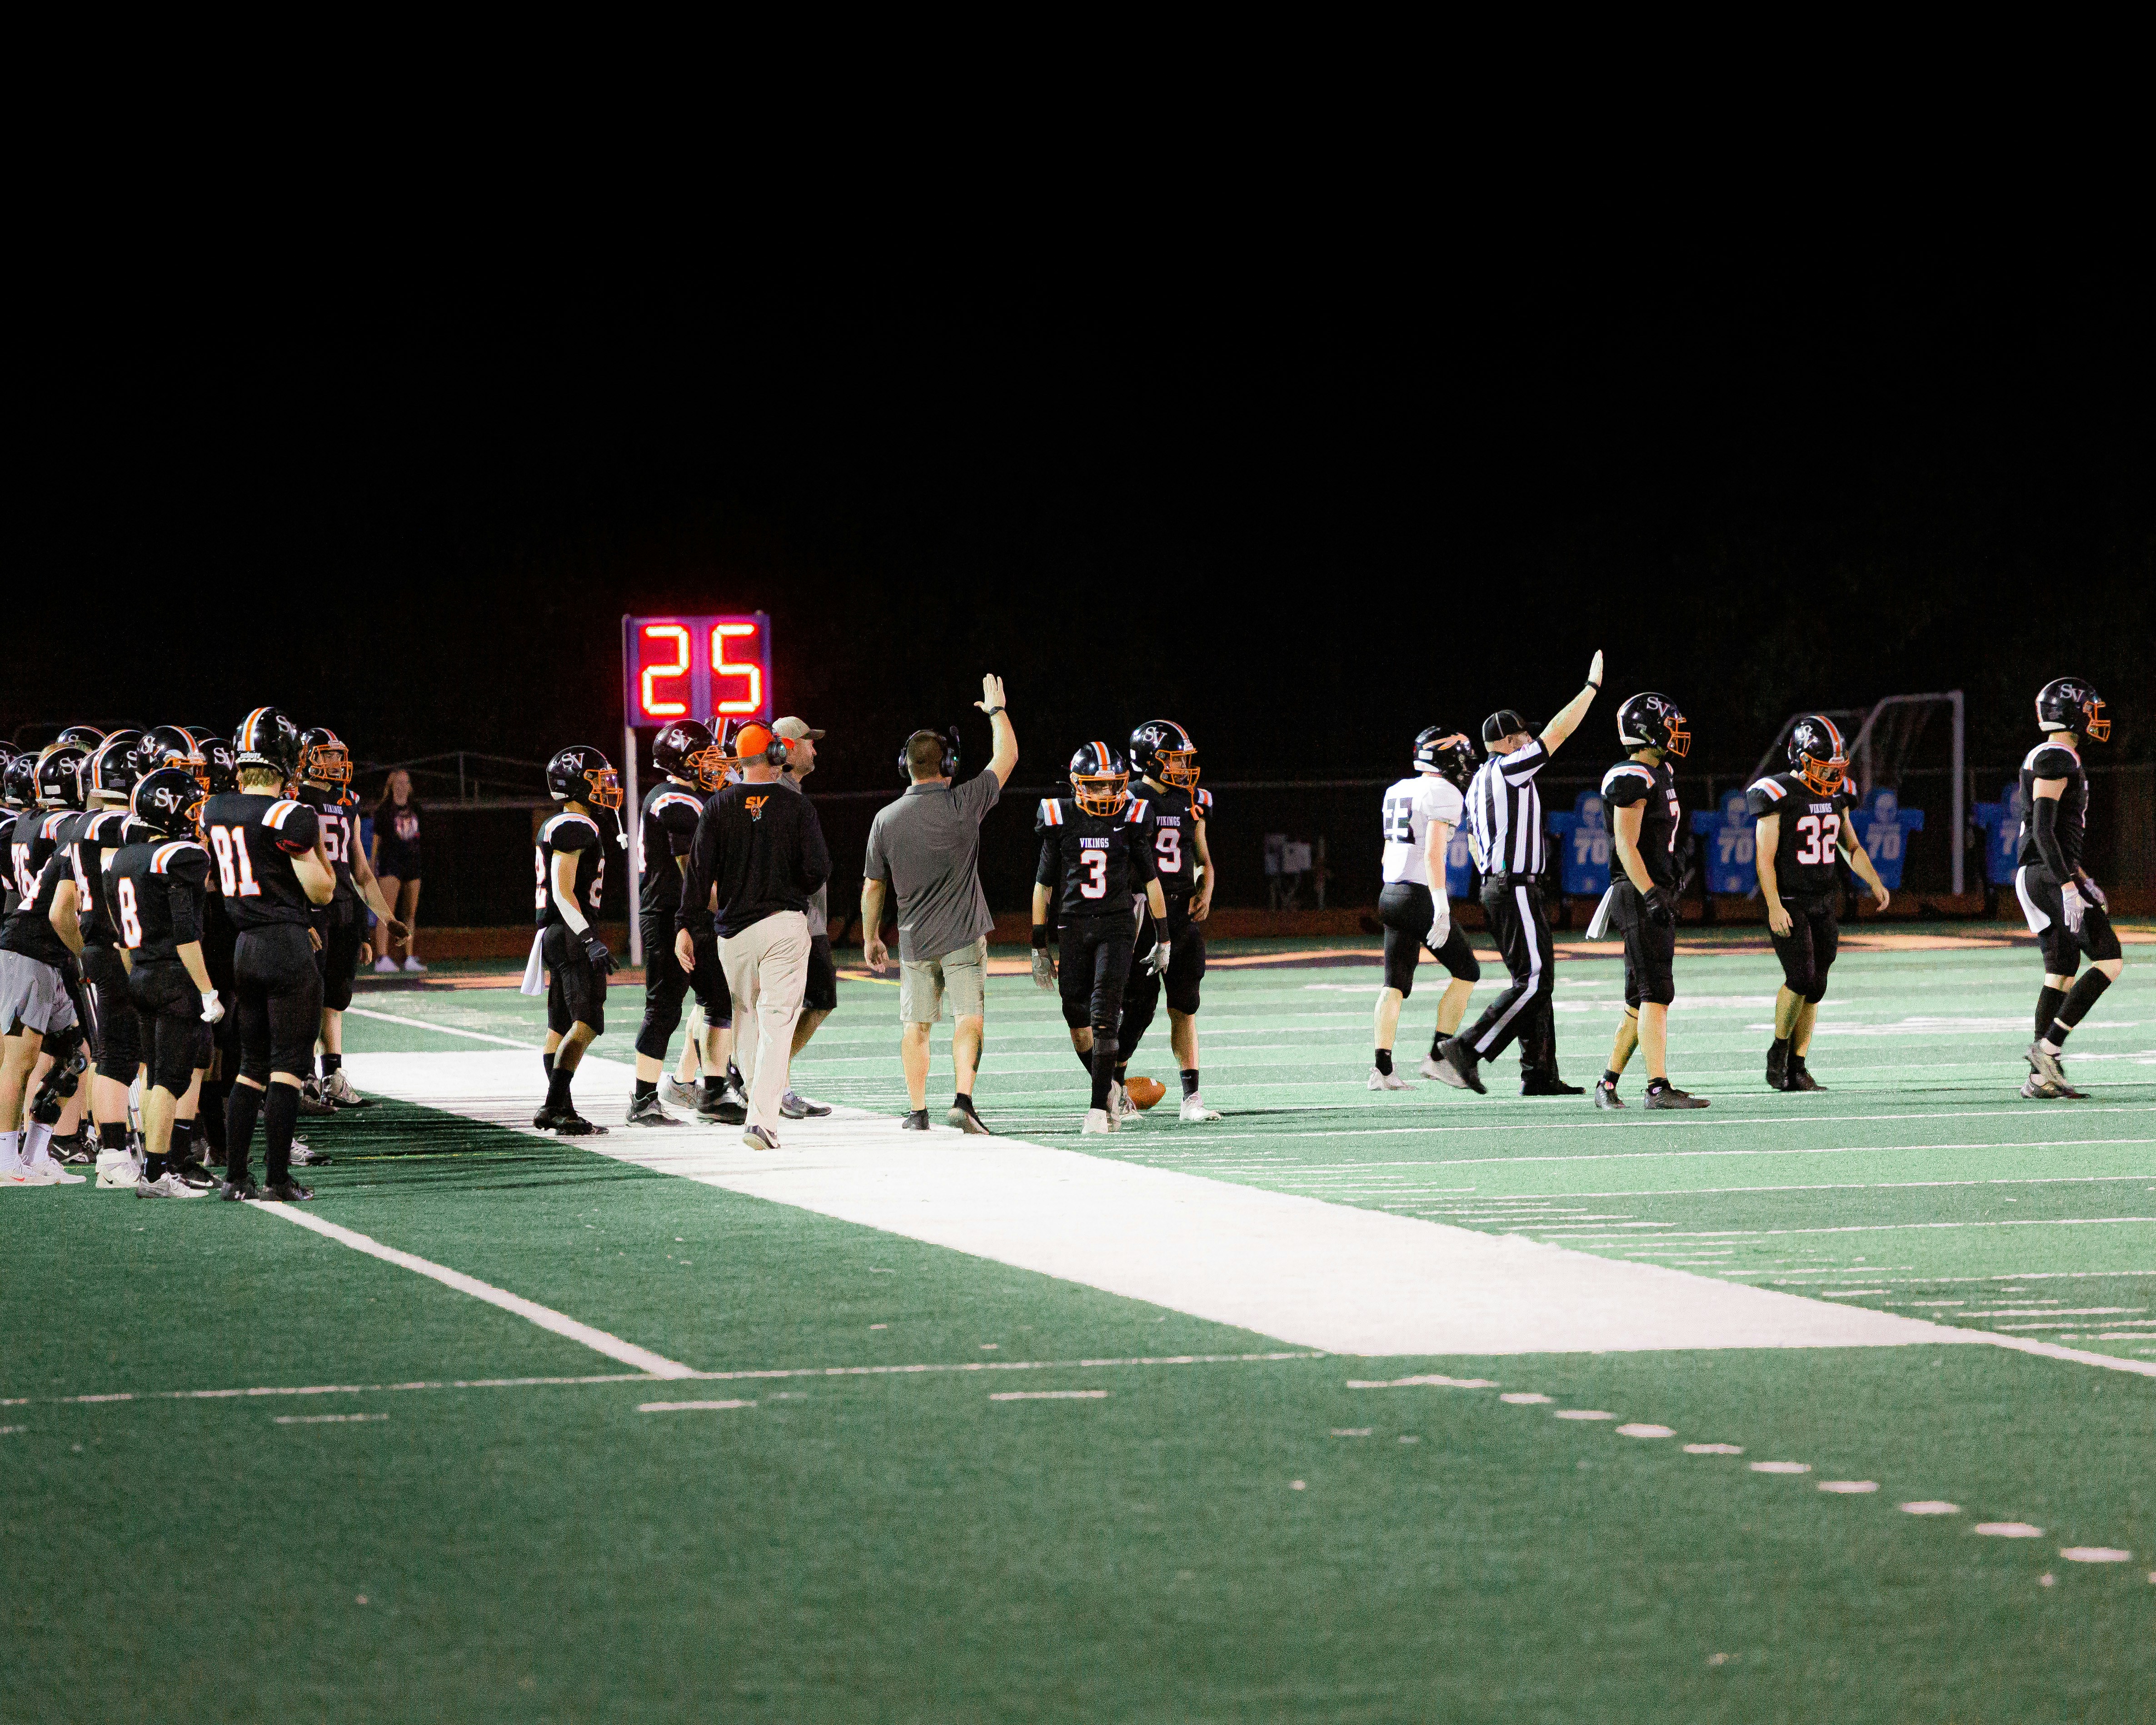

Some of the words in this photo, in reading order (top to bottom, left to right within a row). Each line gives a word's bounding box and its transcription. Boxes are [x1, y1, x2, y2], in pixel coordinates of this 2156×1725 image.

[642, 625, 760, 714] 25
[2060, 684, 2085, 702] SV
[1647, 696, 1670, 717] SV
[667, 729, 694, 752] SV
[1143, 726, 1168, 748] SV
[126, 750, 137, 768] S
[213, 748, 235, 770] SV
[562, 753, 585, 769] SV
[155, 788, 183, 814] SV
[323, 803, 344, 815] VIKINGS
[745, 796, 769, 809] SV
[1809, 803, 1833, 814] VIKINGS
[1156, 816, 1181, 826] VIKINGS
[318, 815, 349, 863] 51
[1079, 838, 1110, 849] VIKINGS
[1797, 815, 1841, 865] 32
[1867, 833, 1901, 860] 70
[210, 825, 262, 897] 81
[1155, 828, 1182, 873] 9
[1574, 839, 1610, 865] 70
[1080, 849, 1108, 899] 3
[118, 877, 142, 950] 8
